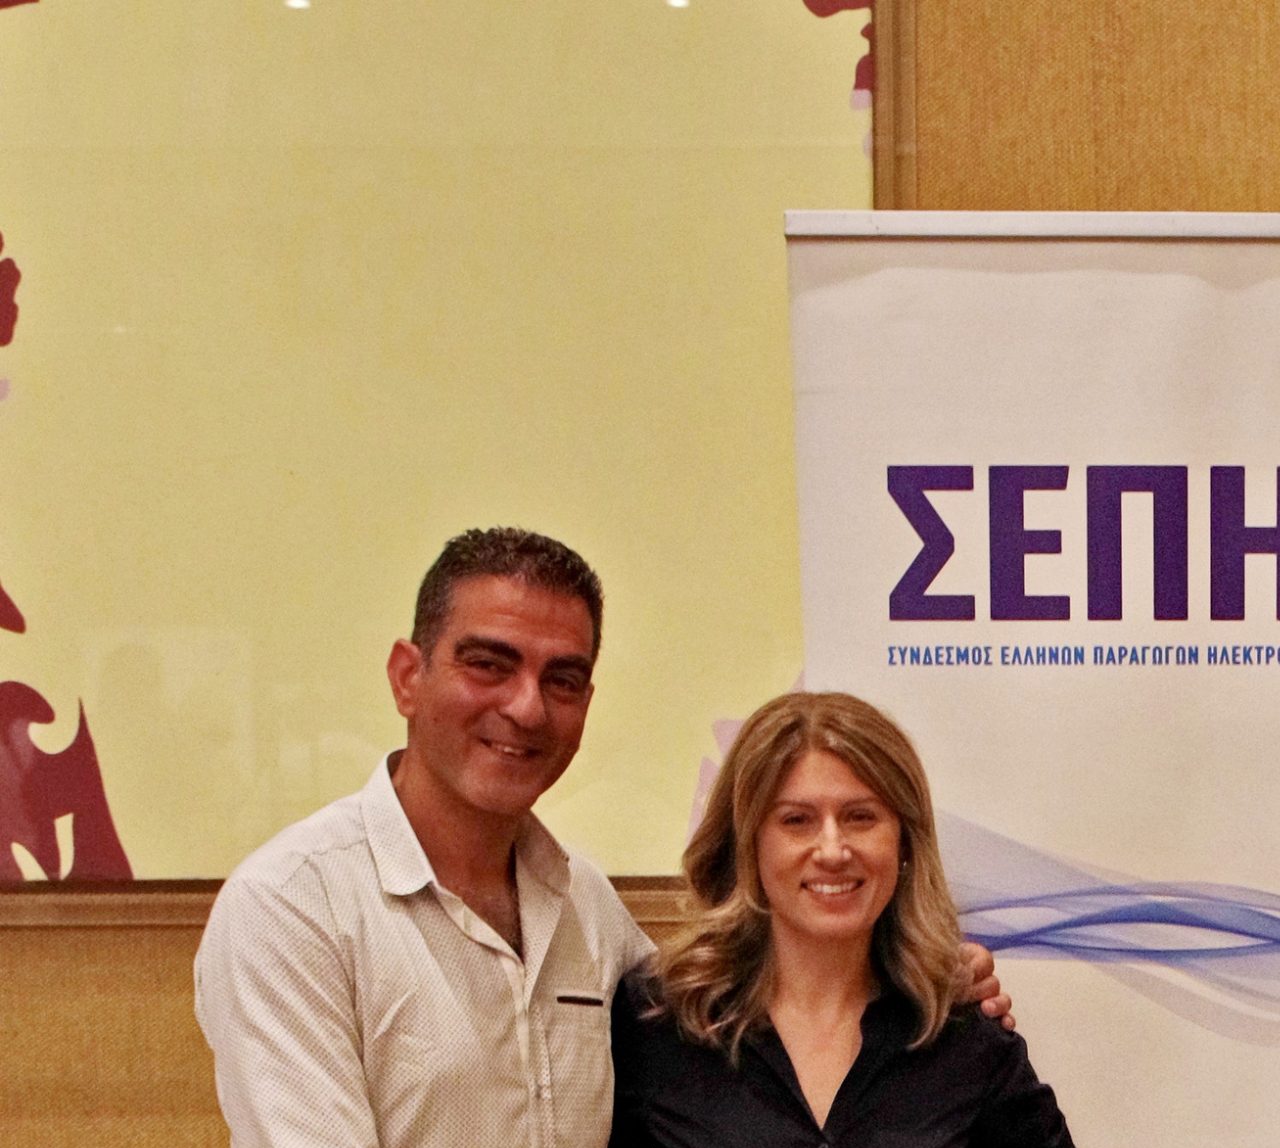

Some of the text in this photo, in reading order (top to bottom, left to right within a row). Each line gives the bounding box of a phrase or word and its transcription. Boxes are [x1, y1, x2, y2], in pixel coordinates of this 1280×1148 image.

[888, 646, 993, 666] ΣΥΝΔΕΣΜΟΣ
[1000, 646, 1086, 666] ΕΛΛΗΝΩΝ
[1093, 646, 1200, 666] ΠΑΡΑΓΩΓΩΝ
